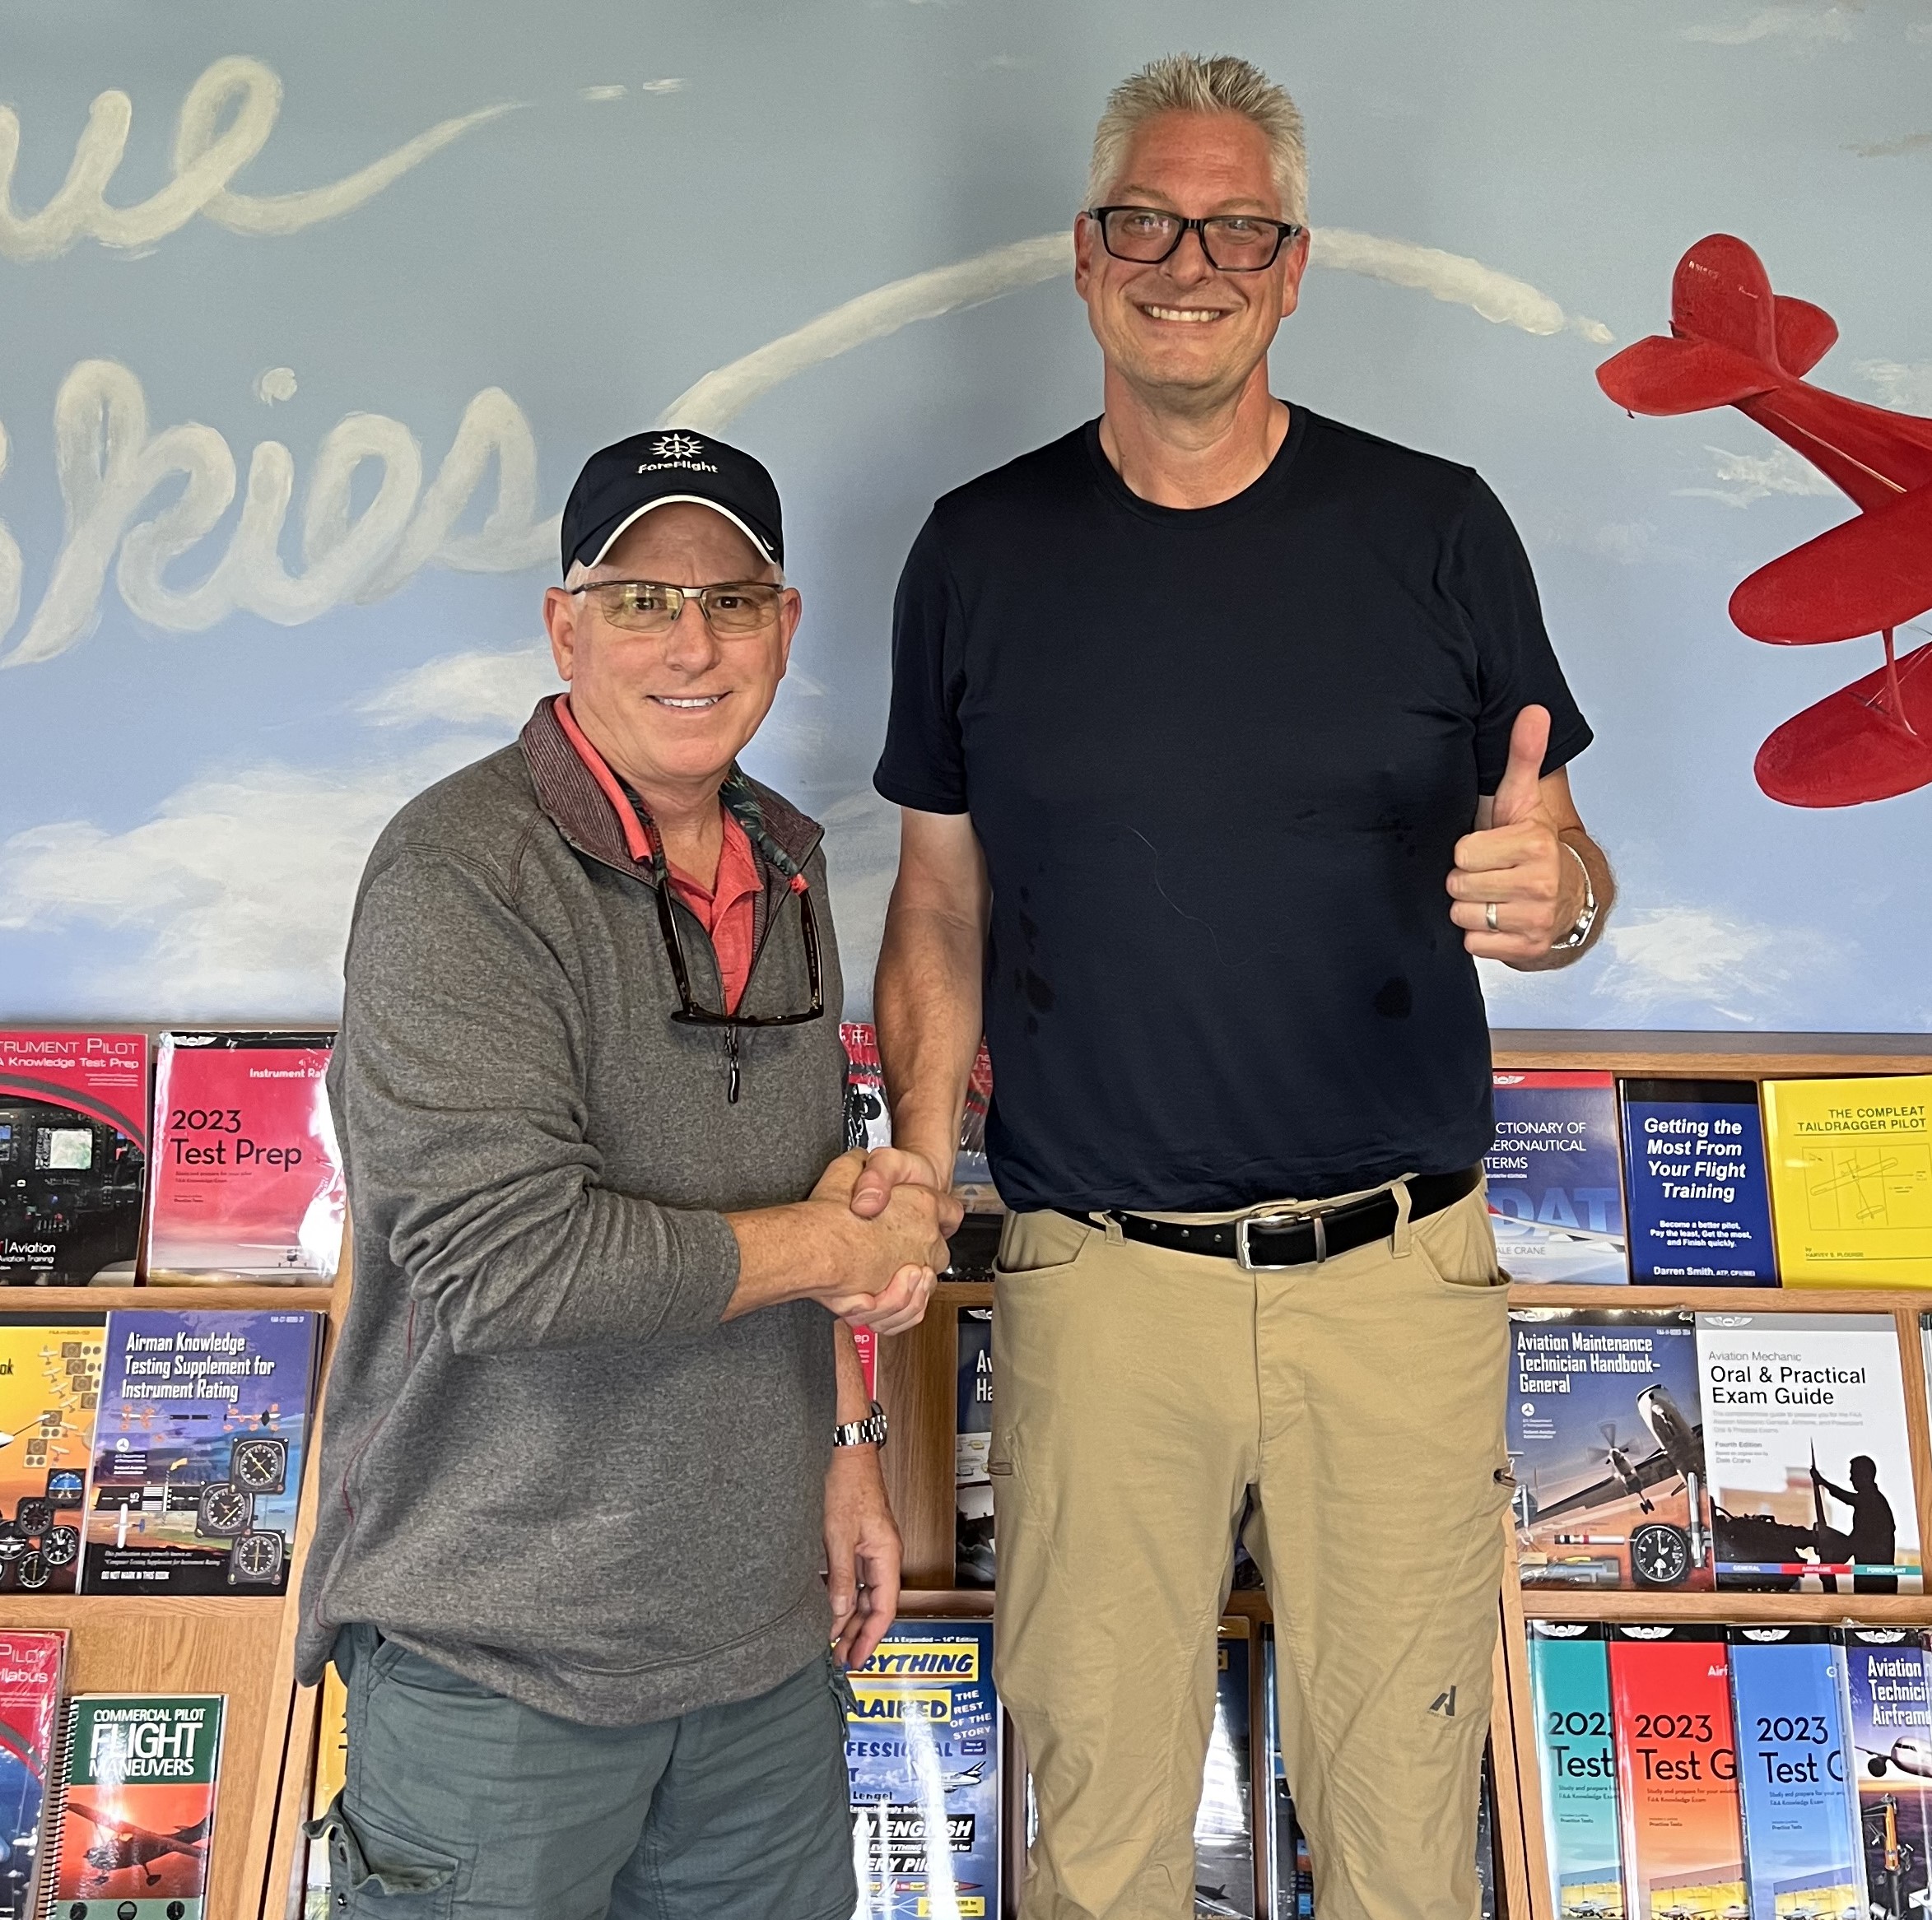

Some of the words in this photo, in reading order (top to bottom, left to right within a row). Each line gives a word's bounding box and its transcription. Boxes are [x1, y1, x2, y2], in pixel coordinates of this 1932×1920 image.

[637, 460, 719, 474] ForeFlight
[86, 1038, 138, 1055] PILOT
[8, 1057, 76, 1069] Knowledge
[79, 1058, 106, 1067] Test
[109, 1058, 139, 1070] Prep
[249, 1067, 305, 1078] Instrument
[170, 1109, 242, 1133] 2023
[1827, 1109, 1853, 1119] THE
[1856, 1105, 1925, 1118] COMPLEAT
[1567, 1122, 1587, 1134] OF
[1644, 1117, 1710, 1138] Getting
[1714, 1118, 1743, 1135] the
[1797, 1119, 1887, 1132] TAILDRAGGER
[1890, 1118, 1927, 1129] PILOT
[170, 1138, 226, 1165] Test
[235, 1138, 302, 1173] Prep
[1646, 1138, 1692, 1155] Most
[1696, 1140, 1743, 1156] From
[1484, 1156, 1529, 1169] TERMS
[1648, 1160, 1692, 1177] Your
[1694, 1161, 1747, 1182] Flight
[1661, 1182, 1735, 1203] Training
[1650, 1229, 1664, 1238] Pay
[1701, 1230, 1716, 1238] Get
[1659, 1220, 1691, 1229] Become
[1697, 1220, 1720, 1229] better
[9, 1242, 56, 1253] Aviation
[1514, 1246, 1546, 1255] CRANE
[1683, 1239, 1706, 1247] Finish
[1653, 1266, 1685, 1276] Darren
[126, 1331, 173, 1351] Airman
[175, 1331, 245, 1355] Knowledge
[1517, 1331, 1569, 1351] Aviation
[1571, 1332, 1653, 1352] Maintenance
[1517, 1352, 1587, 1373] Technician
[1708, 1351, 1749, 1361] Aviation
[1752, 1351, 1802, 1362] Mechanic
[124, 1355, 172, 1379] Testing
[174, 1355, 251, 1379] Supplement
[254, 1355, 275, 1375] for
[1711, 1365, 1752, 1383] Oral
[1759, 1366, 1772, 1383] &
[1780, 1366, 1866, 1383] Practical
[122, 1378, 193, 1398] Instrument
[197, 1379, 239, 1403] Rating
[1519, 1373, 1571, 1393] General
[1712, 1387, 1767, 1404] Exam
[1775, 1387, 1835, 1405] Guide
[1868, 1654, 1922, 1677] Aviation
[955, 1690, 980, 1701] THE
[94, 1708, 172, 1722] COMMERCIAL
[175, 1708, 206, 1721] PILOT
[953, 1701, 984, 1715] REST
[949, 1718, 964, 1728] OF
[966, 1713, 993, 1724] THE
[1548, 1711, 1613, 1740] 202
[1634, 1714, 1713, 1743] 2023
[952, 1726, 991, 1741] STORY
[1757, 1717, 1828, 1745] 2023
[90, 1722, 203, 1759] FLIGHT
[89, 1758, 194, 1778] MANEUVERS
[1549, 1745, 1614, 1778] Test
[1636, 1748, 1702, 1780] Test
[1759, 1751, 1820, 1784] Test
[853, 1791, 893, 1802] Lengel
